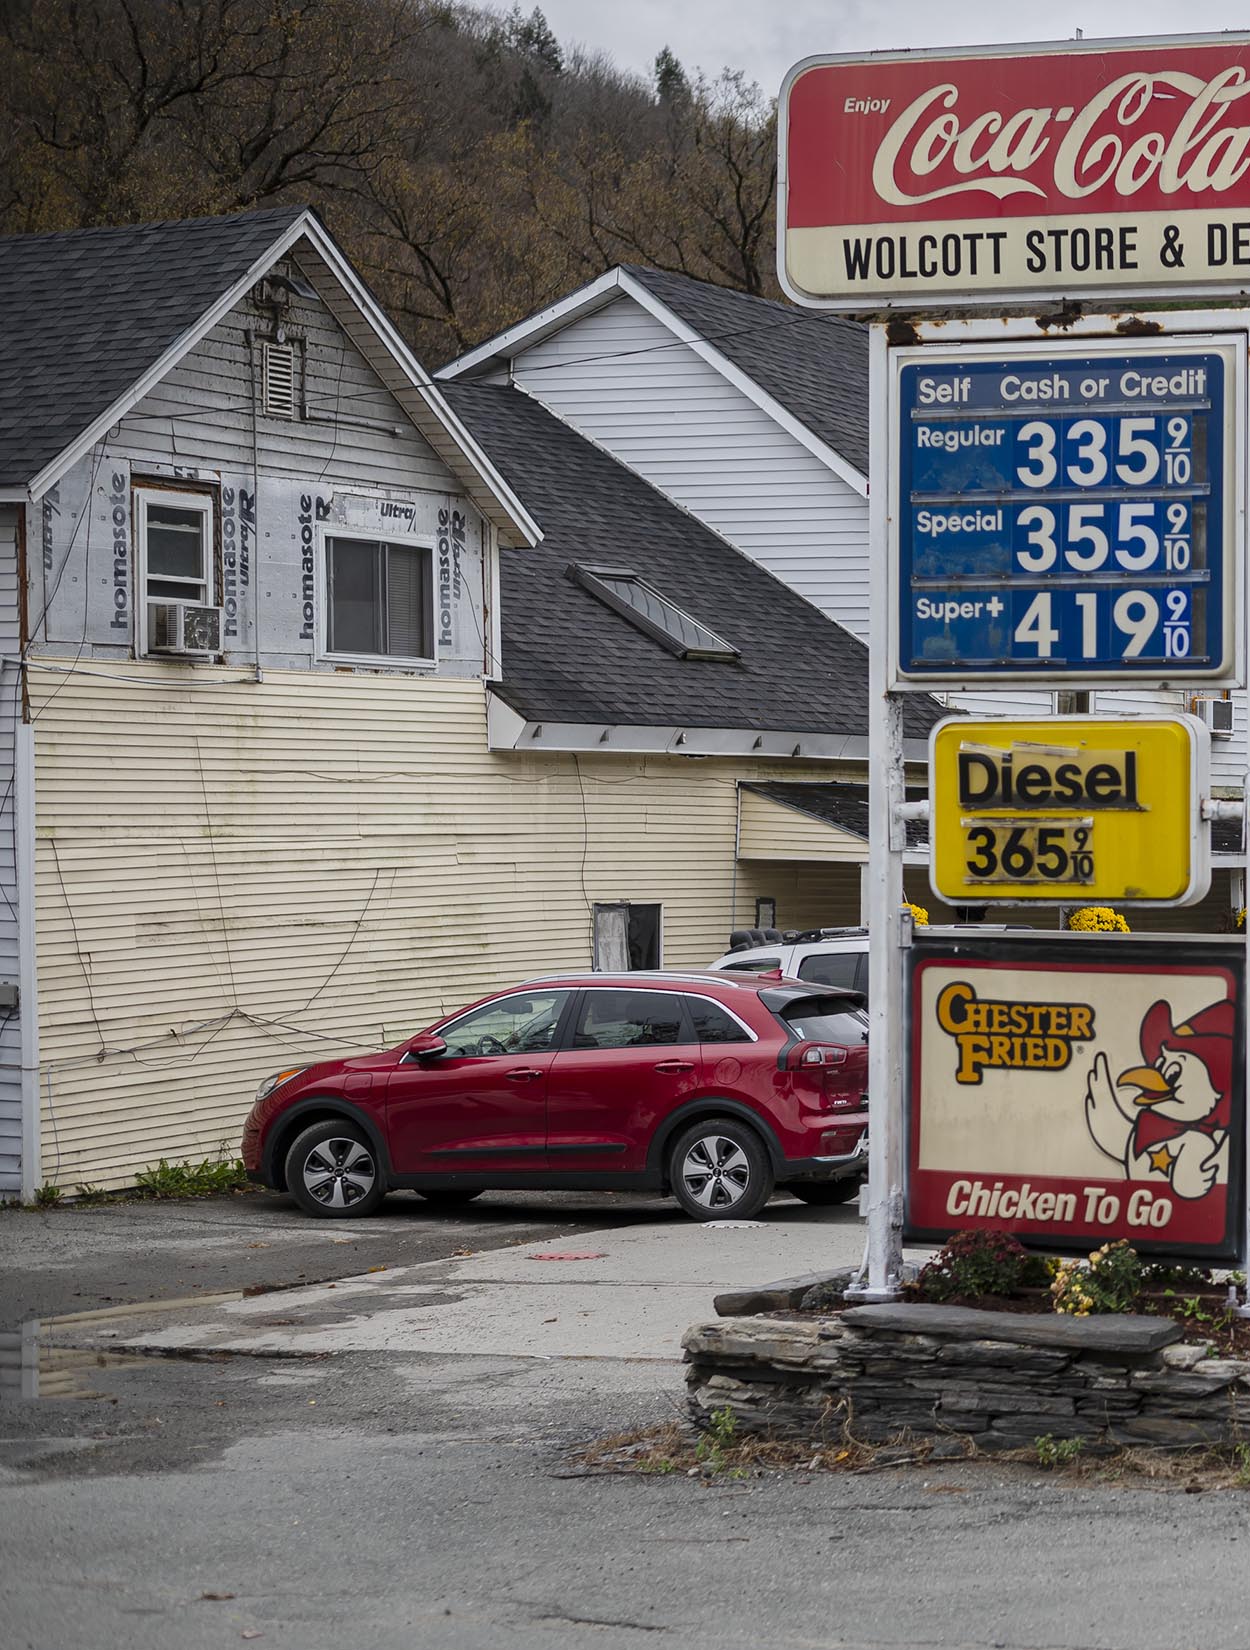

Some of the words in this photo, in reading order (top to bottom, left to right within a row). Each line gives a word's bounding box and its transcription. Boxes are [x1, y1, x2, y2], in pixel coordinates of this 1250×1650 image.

[844, 96, 890, 115] Enjoy
[843, 231, 1008, 280] WOLCOTT
[1026, 226, 1138, 273] STORE
[1160, 224, 1185, 268] &
[919, 377, 971, 404] Self
[1000, 373, 1069, 401] Cash
[1080, 377, 1110, 397] or
[1120, 369, 1206, 397] Credit
[917, 425, 1005, 452] Regular
[1016, 417, 1160, 488] 335
[110, 472, 128, 628] homasote
[917, 509, 1002, 537] Special
[1016, 503, 1159, 572] 355
[298, 494, 314, 640] homasote
[436, 508, 452, 646] homasote
[917, 596, 1004, 622] Super+
[1014, 590, 1159, 658] 419
[958, 751, 1136, 804] Diesel
[967, 827, 1068, 878] 365
[937, 982, 1095, 1039] CHESTER
[956, 1035, 1071, 1085] FRIED
[947, 1180, 1077, 1222] Chicken
[1082, 1187, 1120, 1225] To
[1127, 1189, 1172, 1228] Go
